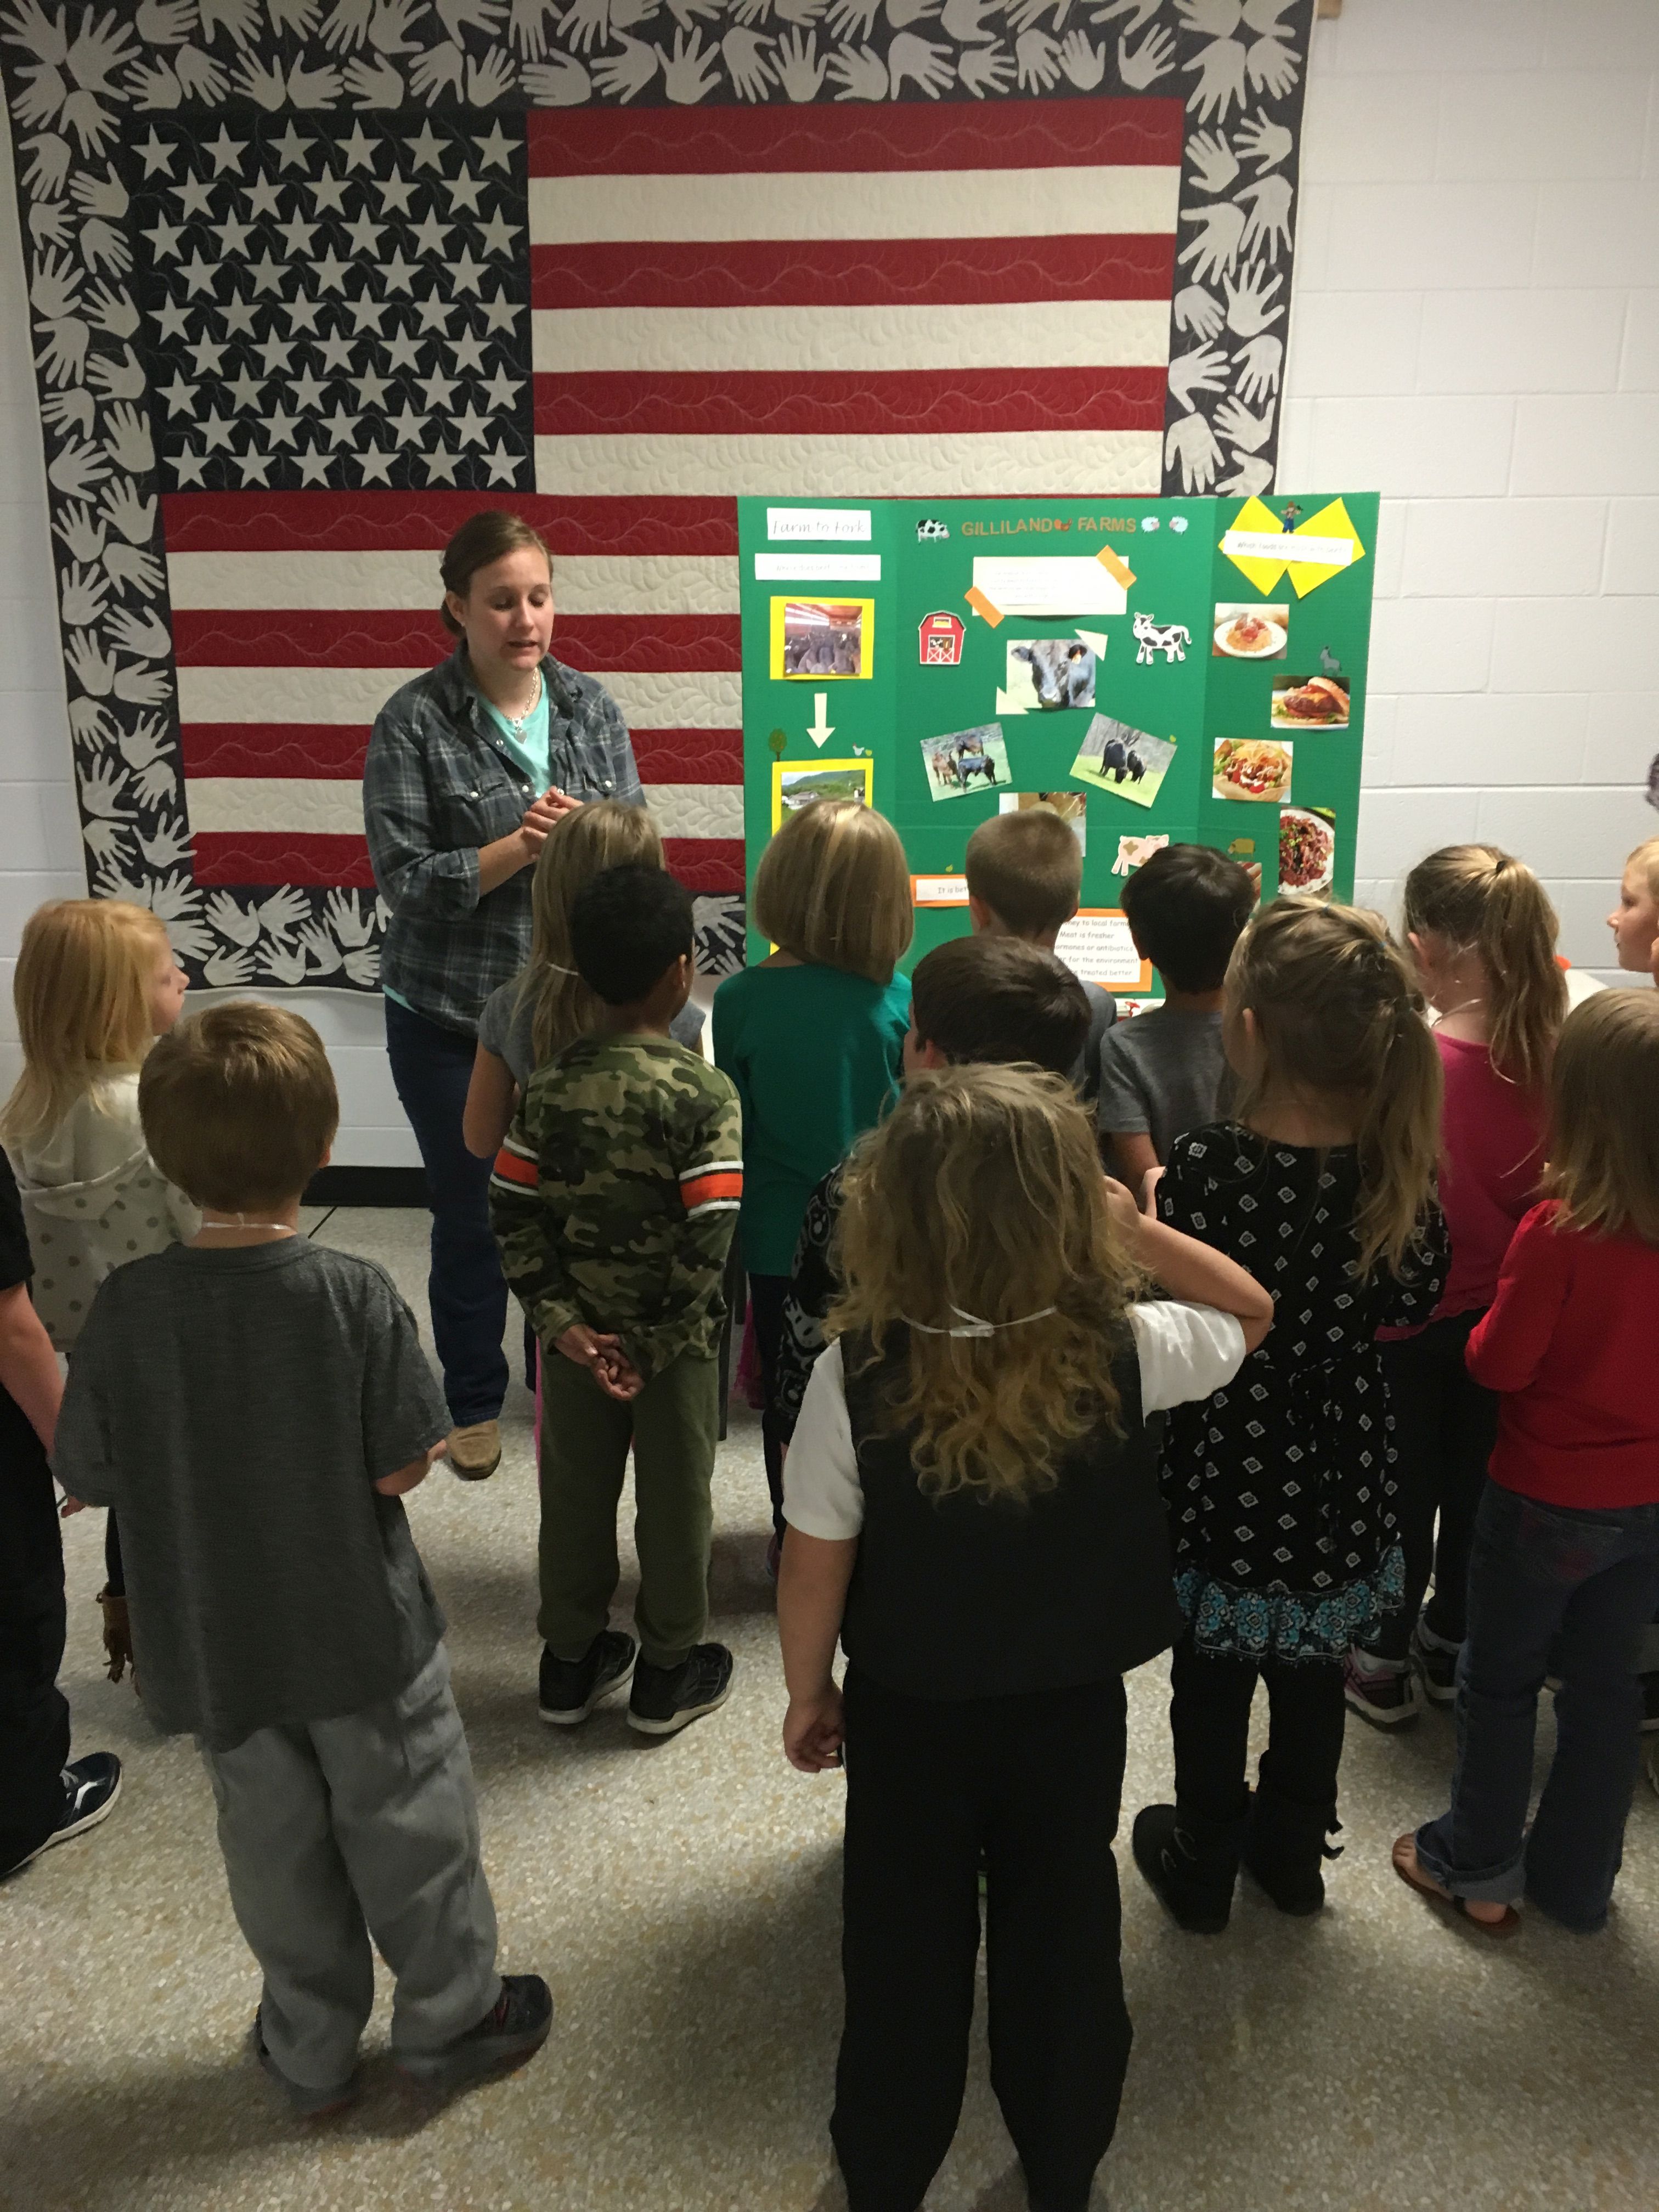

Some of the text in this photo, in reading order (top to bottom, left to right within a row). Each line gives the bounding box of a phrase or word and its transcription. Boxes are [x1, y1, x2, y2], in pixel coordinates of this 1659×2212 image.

[816, 521, 830, 533] to
[961, 517, 1137, 536] GILLILAND FARMS
[1088, 931, 1114, 939] fresher
